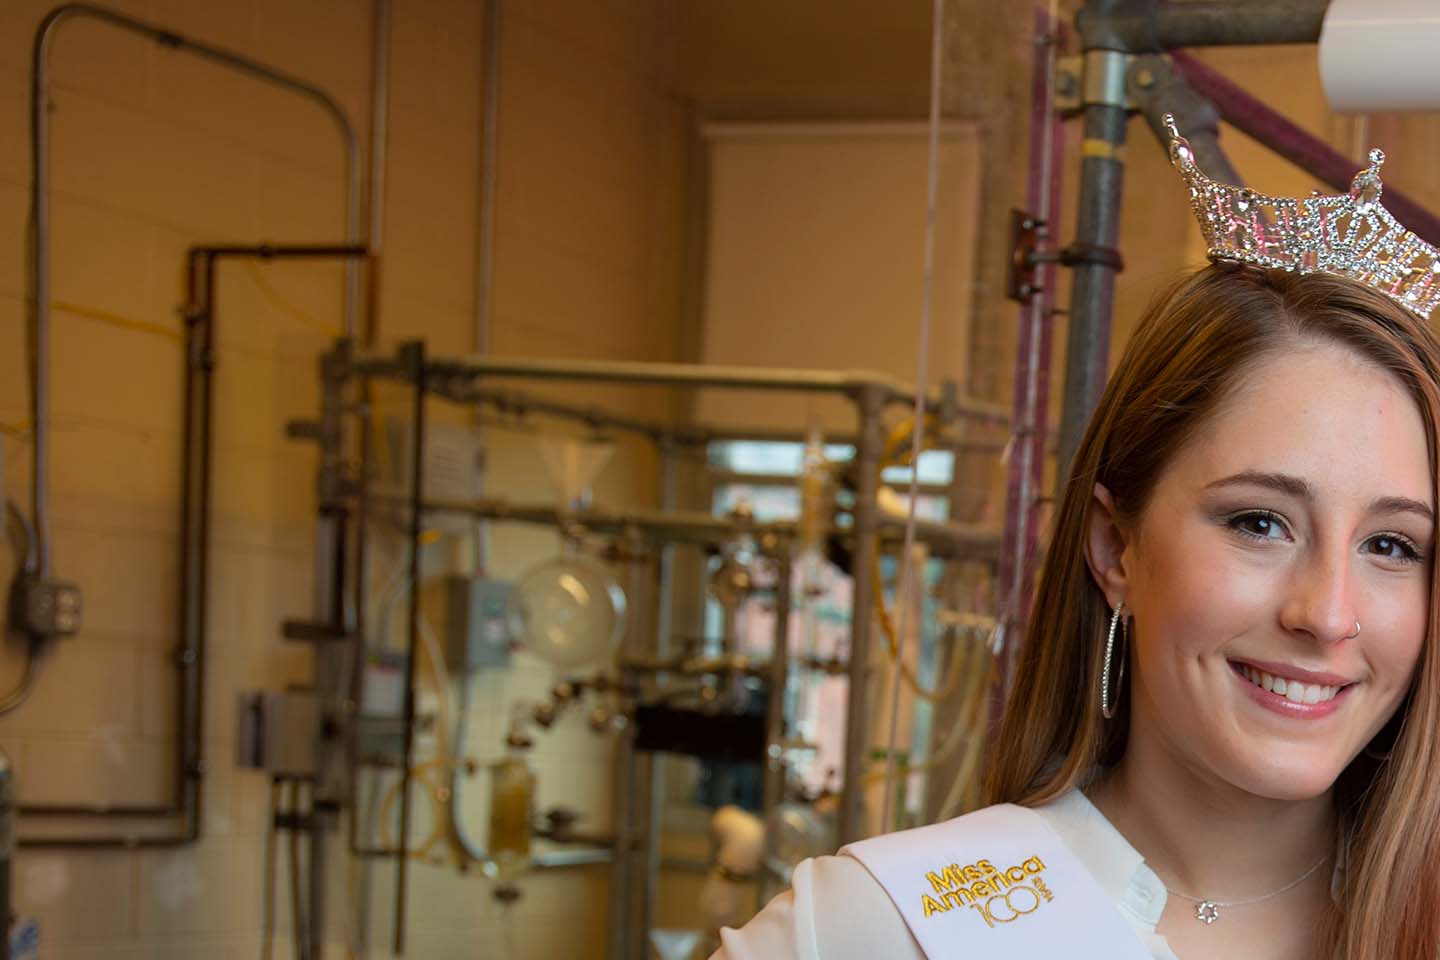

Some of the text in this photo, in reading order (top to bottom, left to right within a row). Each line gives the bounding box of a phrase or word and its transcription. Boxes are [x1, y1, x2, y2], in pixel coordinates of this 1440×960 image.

[921, 855, 1046, 918] America
[925, 859, 996, 893] Miss
[969, 885, 1040, 929] 100
